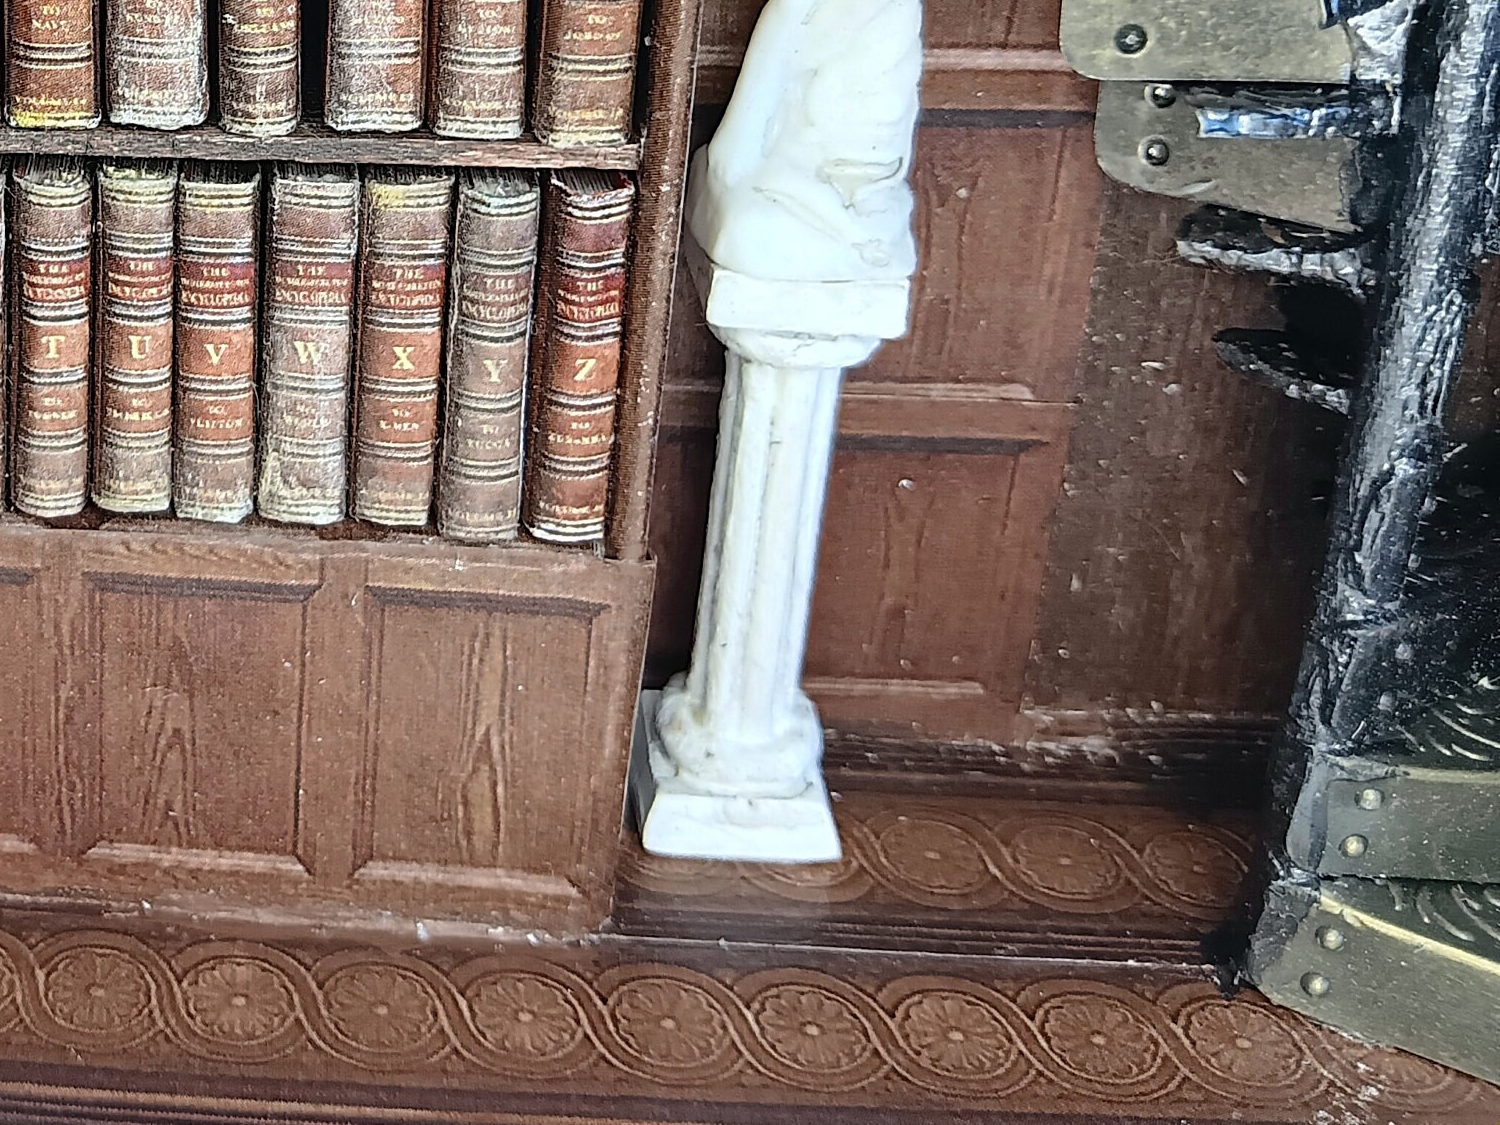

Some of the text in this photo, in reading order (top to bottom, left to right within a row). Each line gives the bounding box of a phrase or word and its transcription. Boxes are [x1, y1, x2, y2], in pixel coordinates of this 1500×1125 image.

[394, 268, 424, 279] THE
[486, 278, 513, 290] THE
[577, 280, 604, 292] THE
[41, 335, 65, 359] T
[129, 335, 152, 360] U
[204, 344, 229, 365] V
[294, 340, 330, 366] W
[392, 346, 415, 370] X
[483, 359, 508, 382] Y
[573, 358, 597, 381] Z
